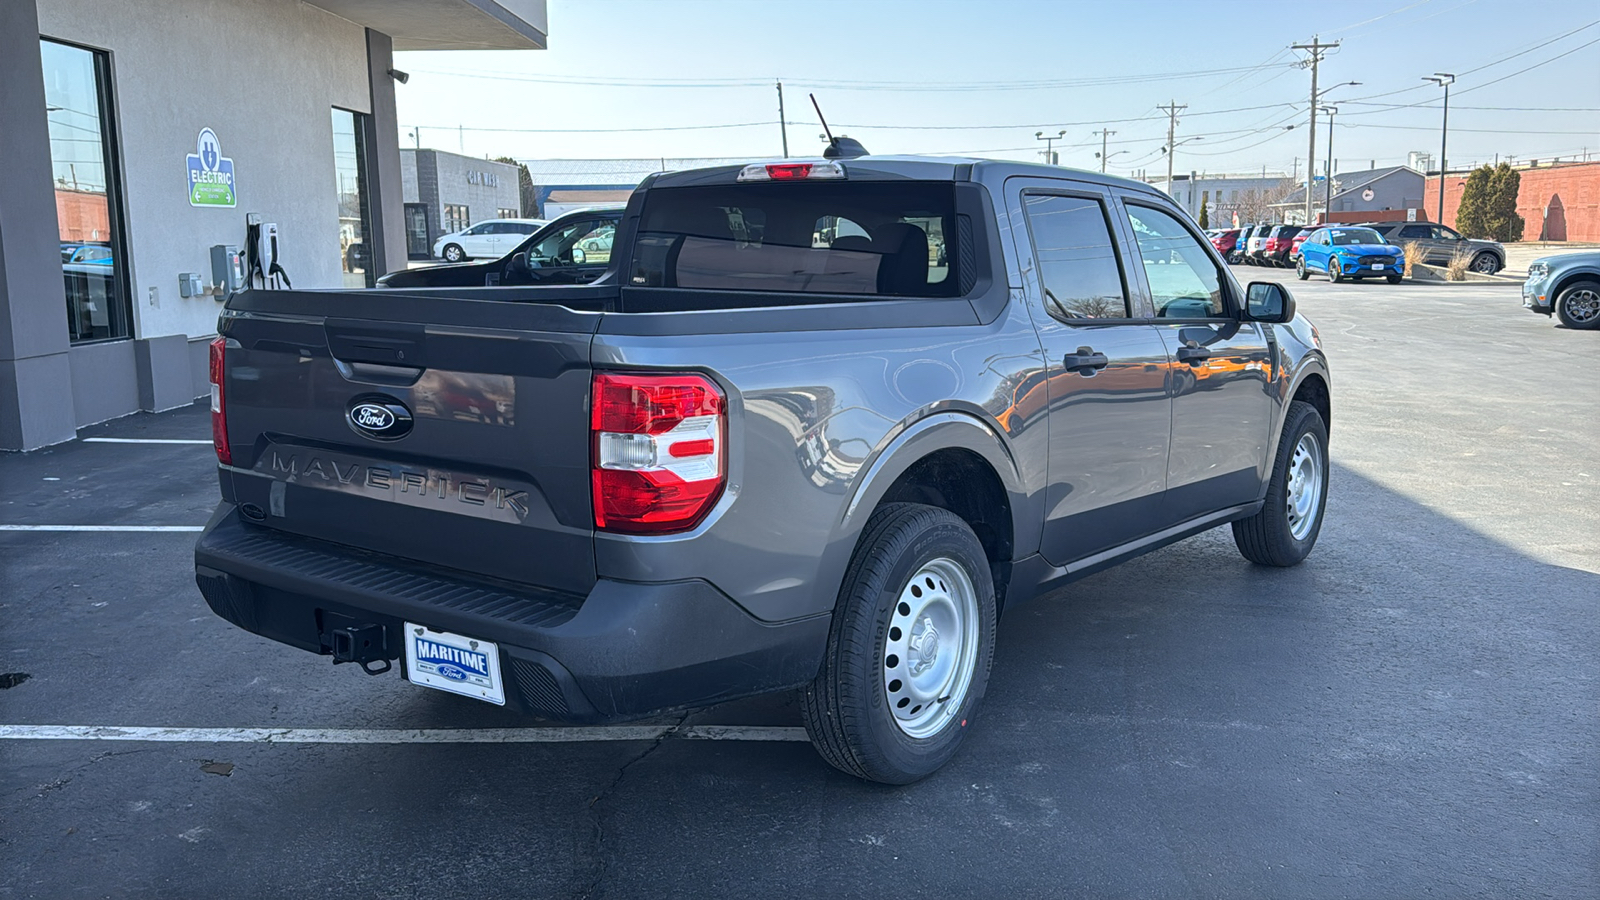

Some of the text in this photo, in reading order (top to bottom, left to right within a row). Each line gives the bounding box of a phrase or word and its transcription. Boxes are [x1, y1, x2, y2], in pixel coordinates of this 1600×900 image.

[191, 169, 232, 185] ELECTRIC
[358, 406, 386, 427] Ford
[272, 451, 529, 517] MAVERICK
[417, 639, 487, 675] MARITIME
[442, 666, 463, 680] Ford
